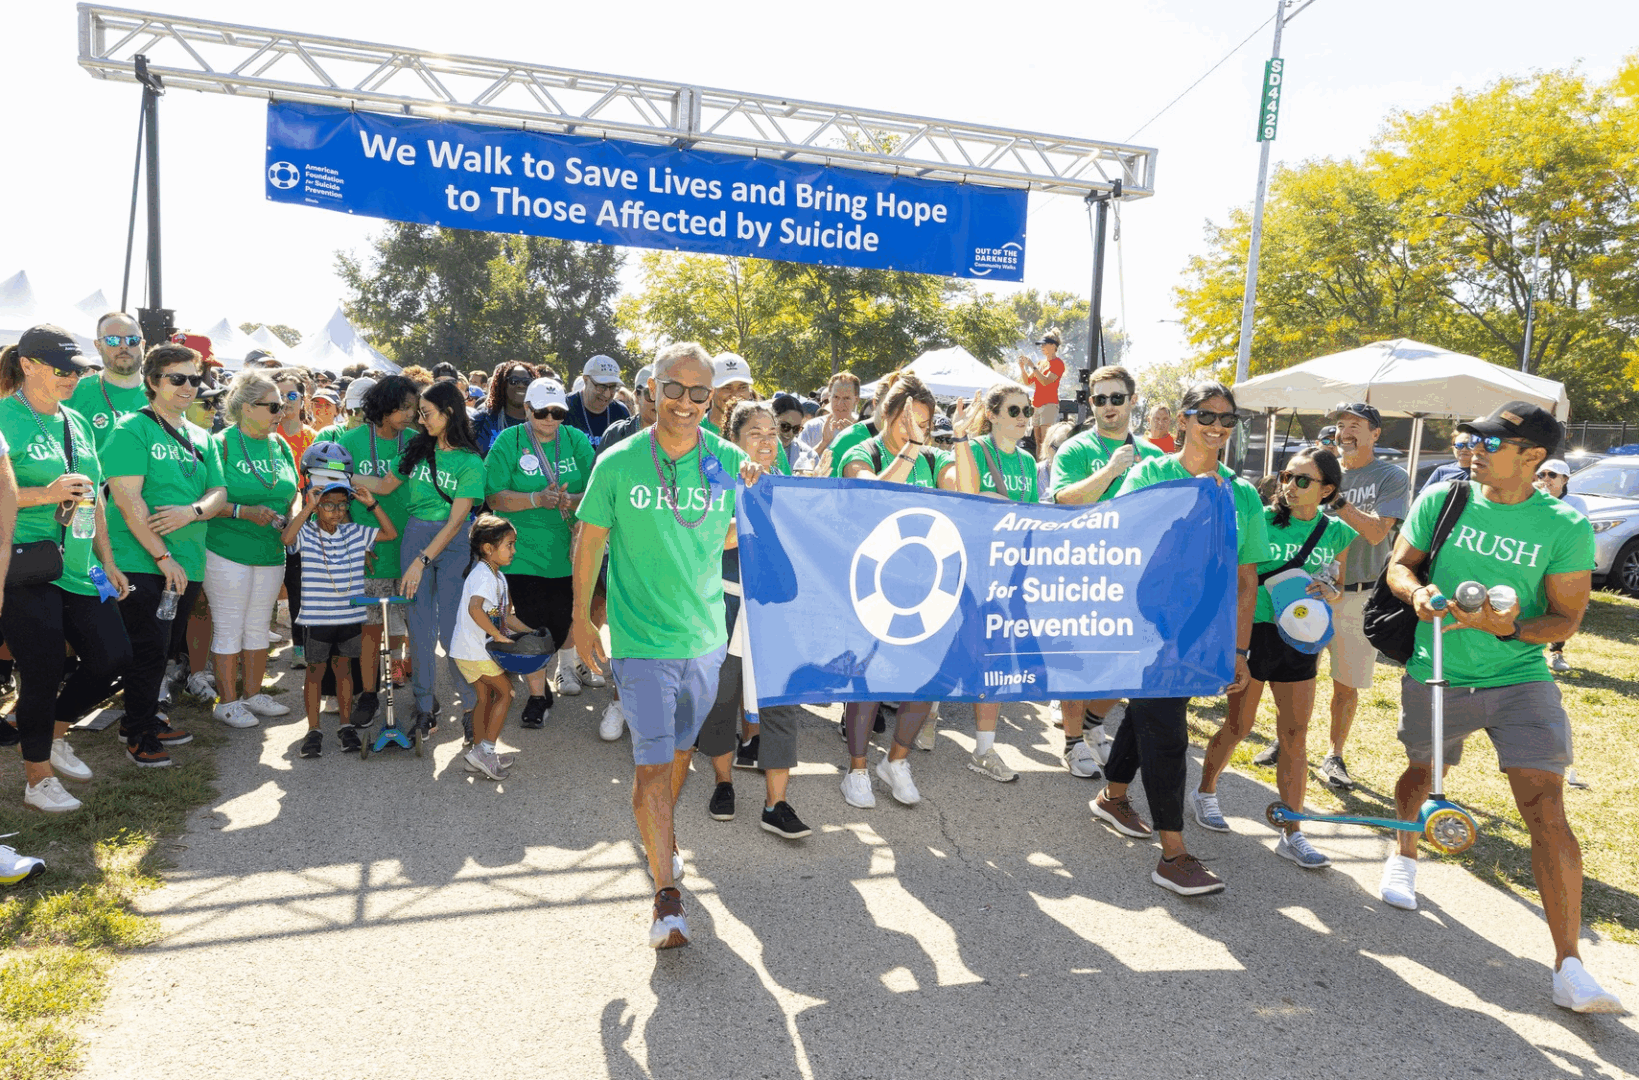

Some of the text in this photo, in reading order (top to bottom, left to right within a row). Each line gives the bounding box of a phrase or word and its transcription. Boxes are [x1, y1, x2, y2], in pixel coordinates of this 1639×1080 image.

[1264, 60, 1282, 139] SD4429
[305, 163, 339, 175] American
[305, 171, 345, 184] Foundation
[360, 130, 947, 227] We Walk to Save Lives and Bring Hope
[305, 185, 343, 199] Prevention
[314, 180, 341, 191] Suicide
[445, 184, 879, 252] to Those Affected by Suicide
[975, 255, 1018, 264] DARKNESS
[419, 465, 457, 490] RSH
[655, 486, 726, 511] RUSH
[989, 539, 1142, 567] Foundation
[1283, 543, 1334, 566] RSH
[1453, 524, 1542, 568] RUSH
[986, 576, 1124, 602] for Suicide
[986, 610, 1133, 639] Prevention
[984, 670, 1036, 686] Illinois
